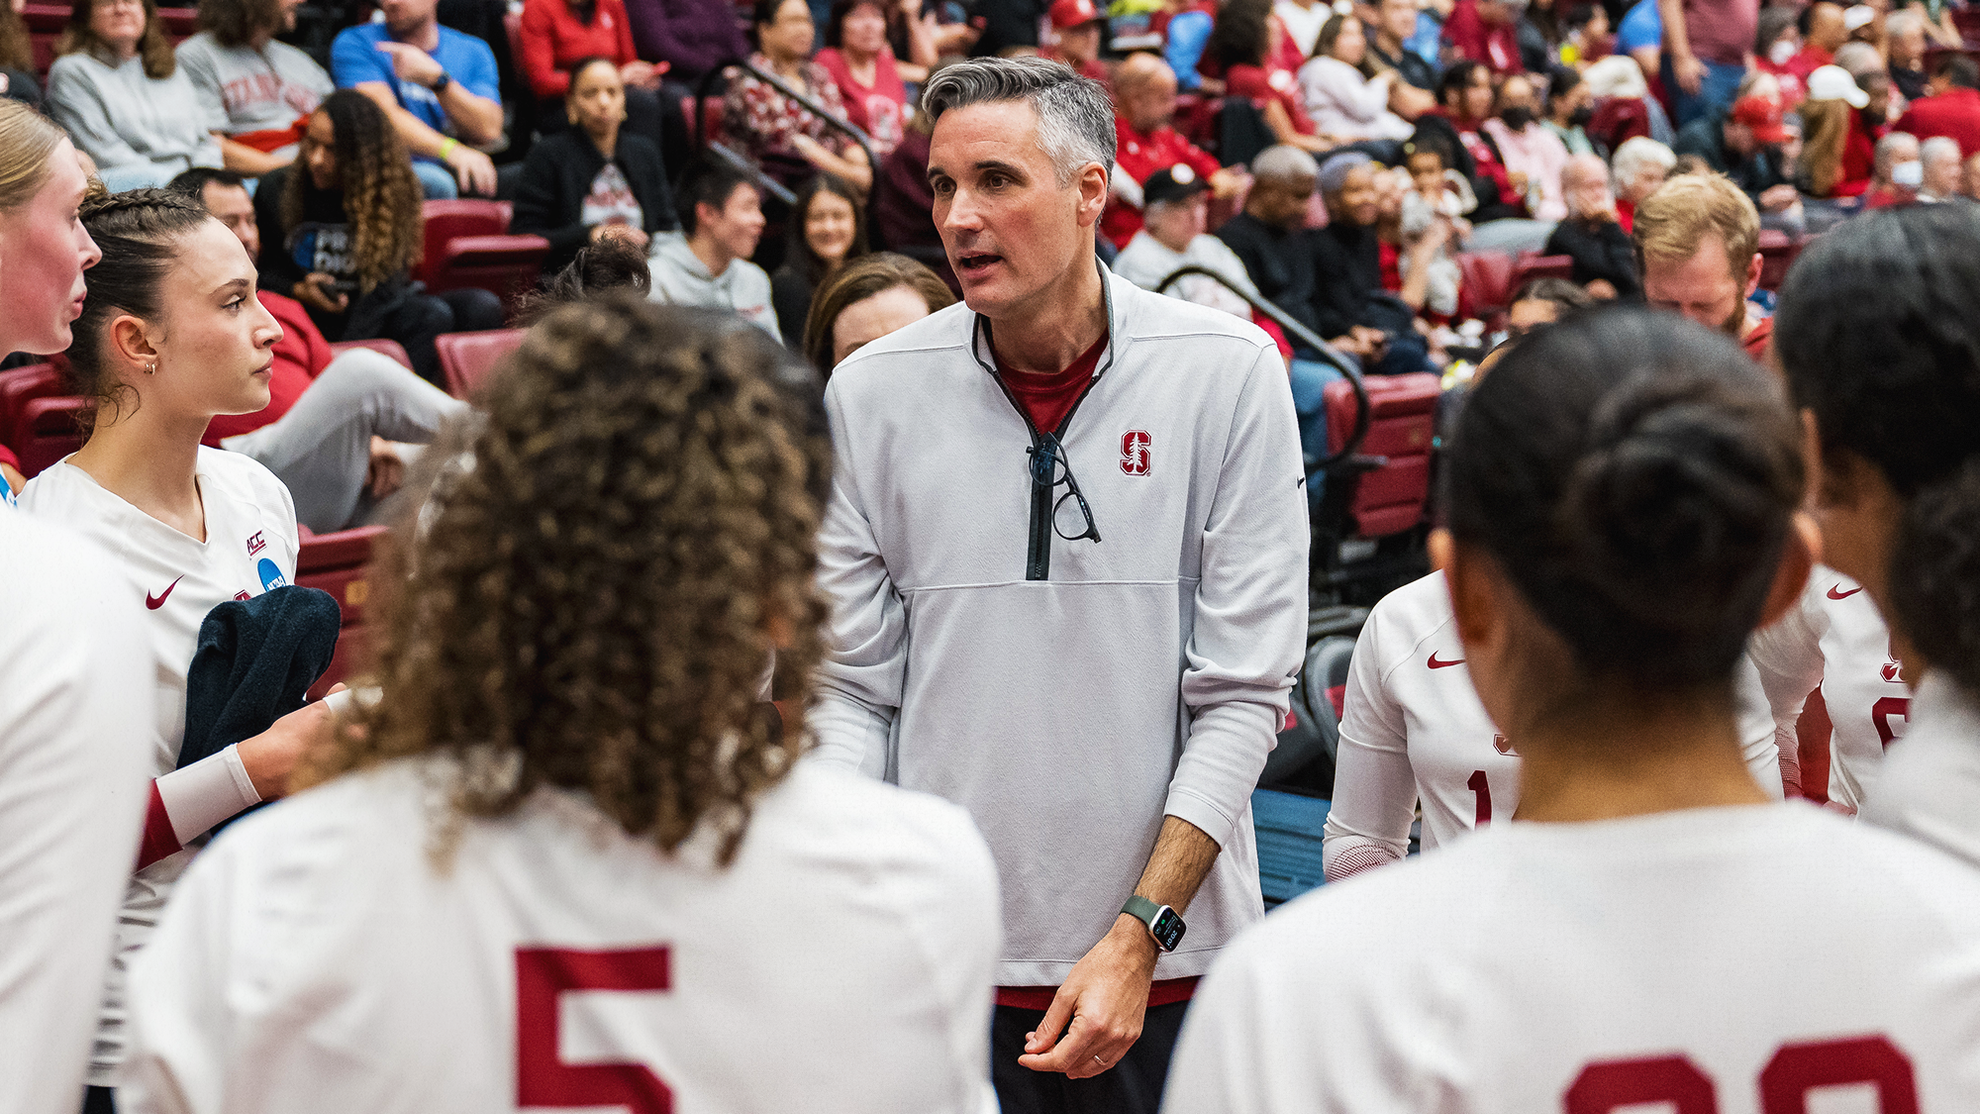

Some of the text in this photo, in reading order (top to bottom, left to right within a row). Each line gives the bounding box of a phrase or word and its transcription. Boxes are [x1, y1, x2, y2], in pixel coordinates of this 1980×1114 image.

[1120, 429, 1151, 476] S
[246, 530, 265, 553] ACC
[512, 944, 673, 1114] 5
